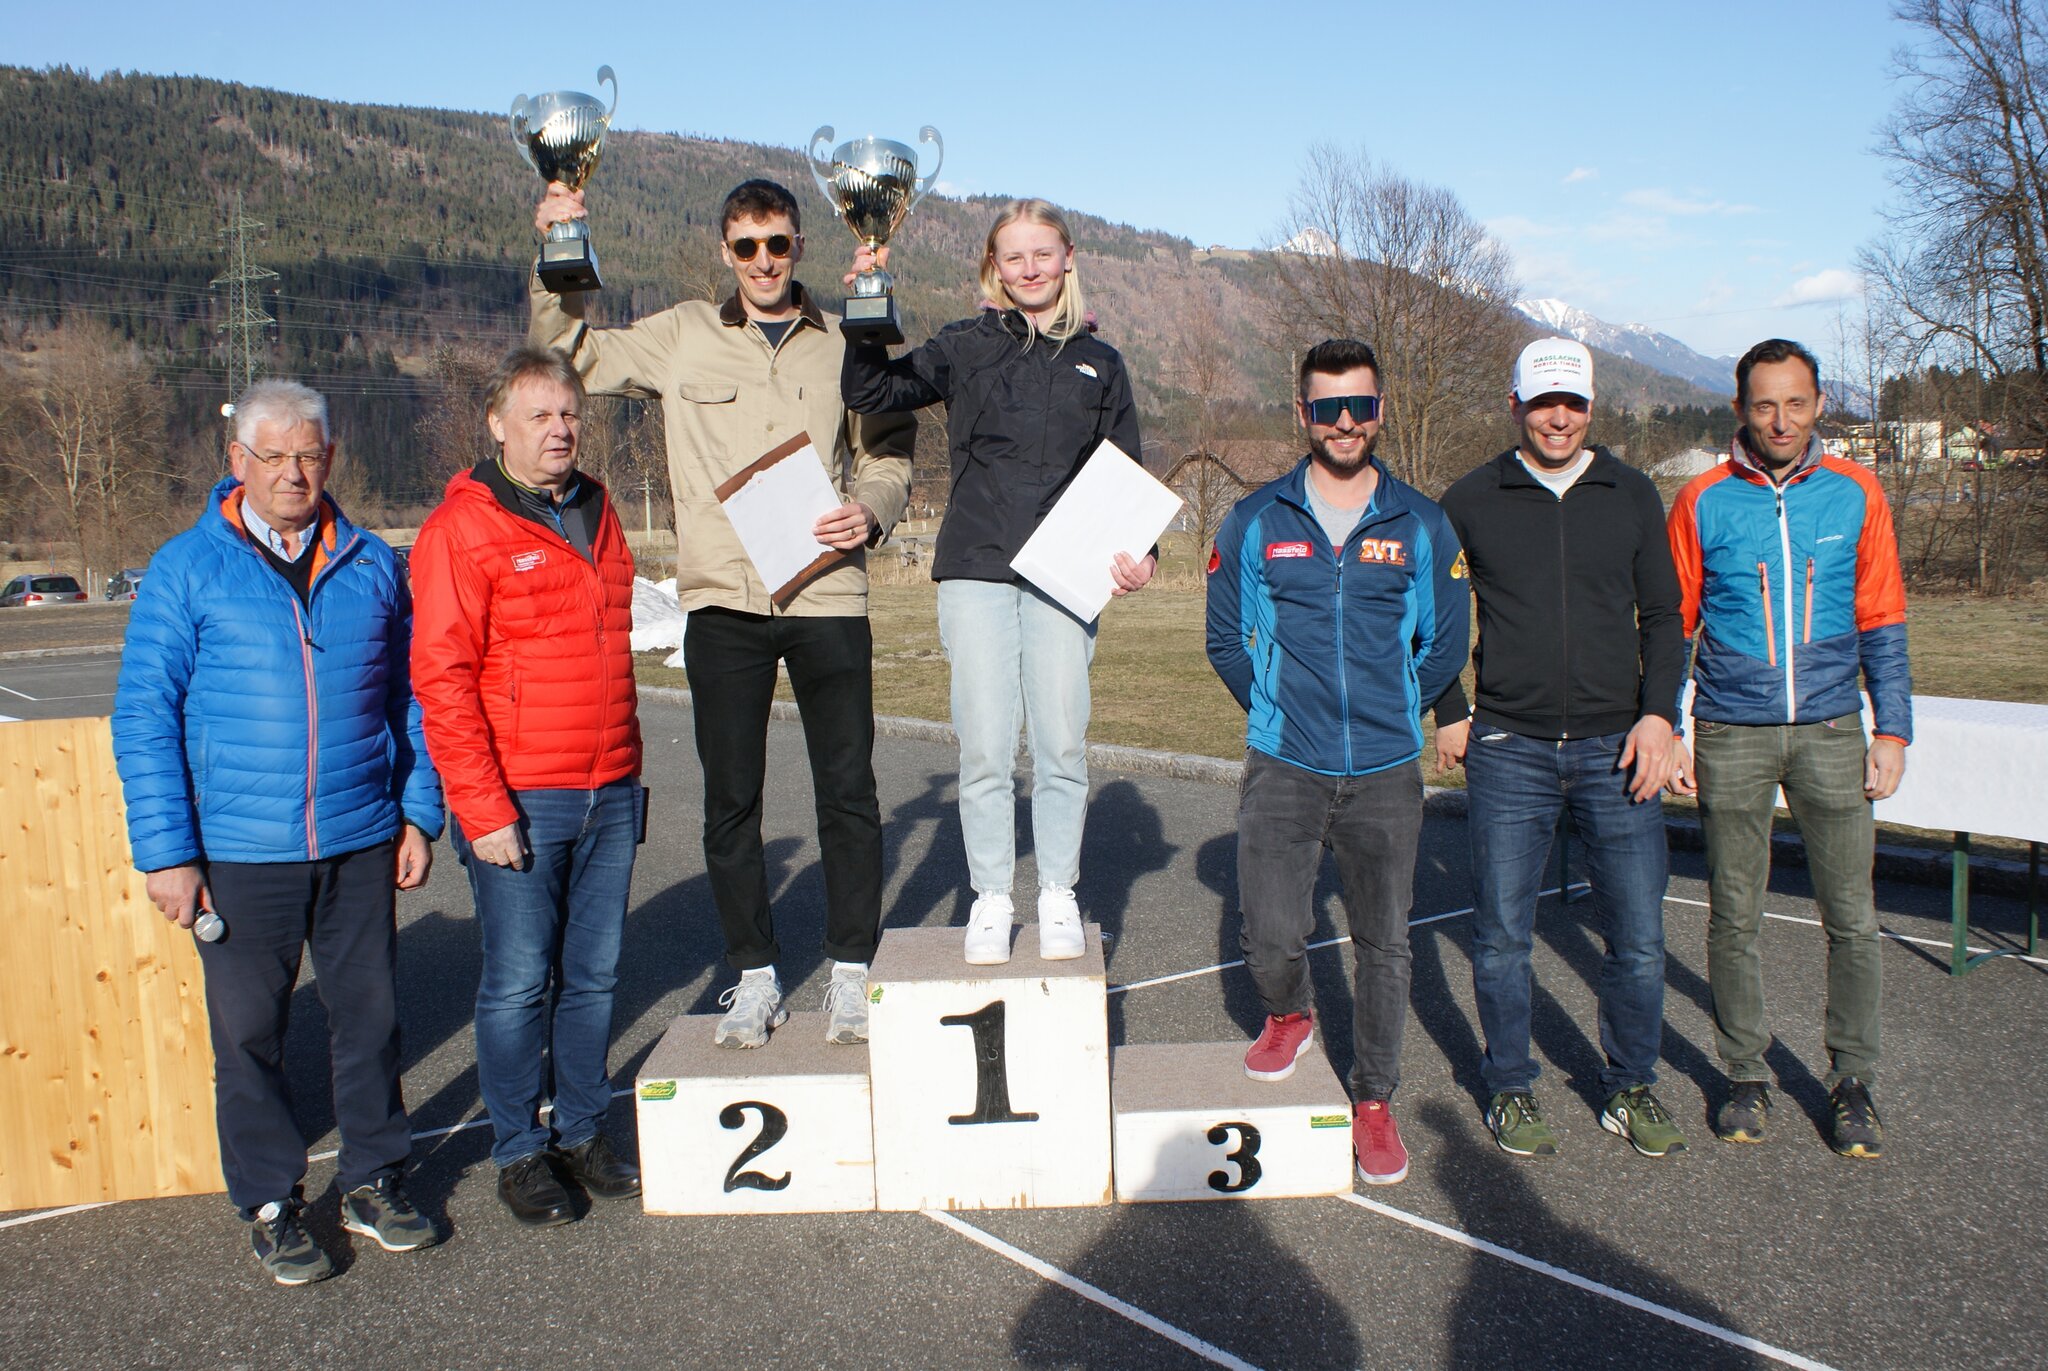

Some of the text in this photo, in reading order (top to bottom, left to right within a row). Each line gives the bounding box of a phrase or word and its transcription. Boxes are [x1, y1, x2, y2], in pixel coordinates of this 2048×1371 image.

[940, 1000, 1040, 1125] 1
[719, 1101, 791, 1192] 2
[1207, 1122, 1262, 1194] 3
